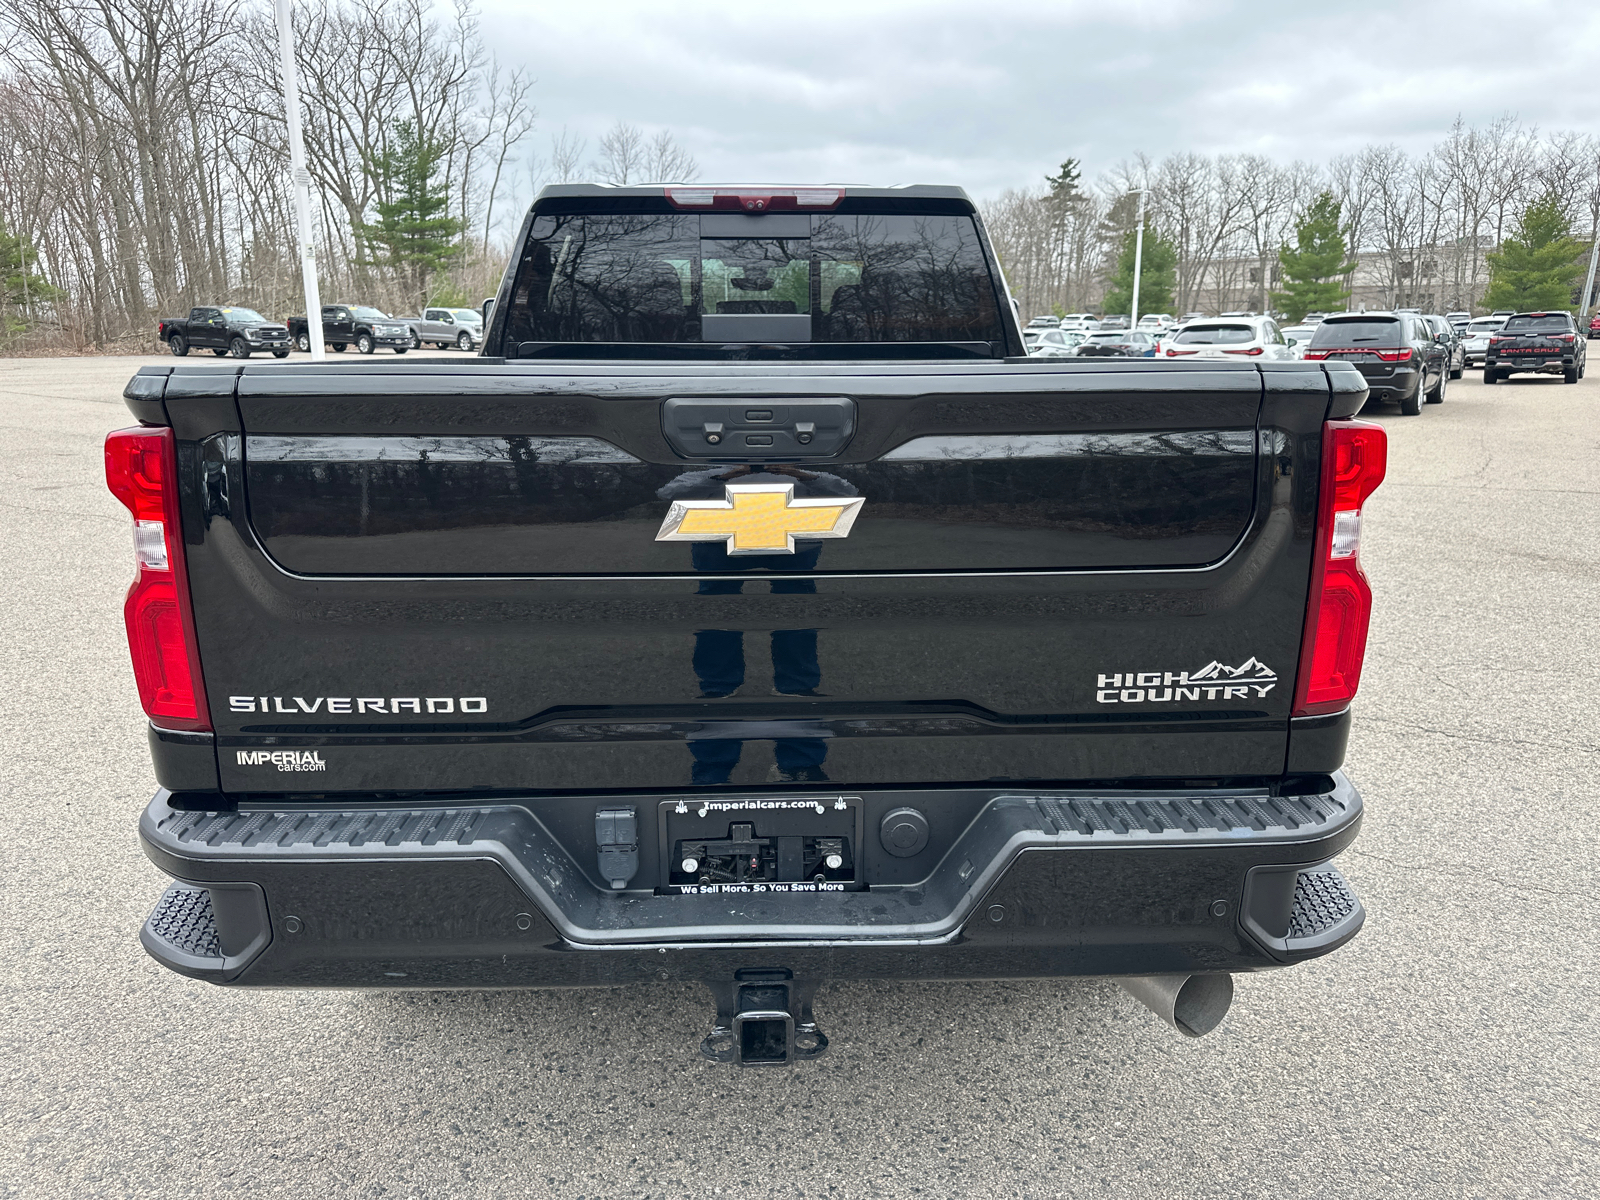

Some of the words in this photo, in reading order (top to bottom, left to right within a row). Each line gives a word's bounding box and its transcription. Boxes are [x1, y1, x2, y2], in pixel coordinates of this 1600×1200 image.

[1097, 671, 1188, 687] HIGH
[1096, 683, 1276, 703] COUNTRY
[228, 696, 488, 713] SILVERADO
[236, 751, 326, 765] IMPERIAL
[277, 763, 326, 772] cars.com
[704, 800, 819, 811] Imperialcars.com
[681, 886, 697, 894] We
[700, 885, 719, 893] Sell
[721, 884, 750, 893] More,
[753, 884, 767, 892] So
[769, 884, 788, 892] You
[791, 884, 816, 892] Save
[818, 883, 844, 891] More
